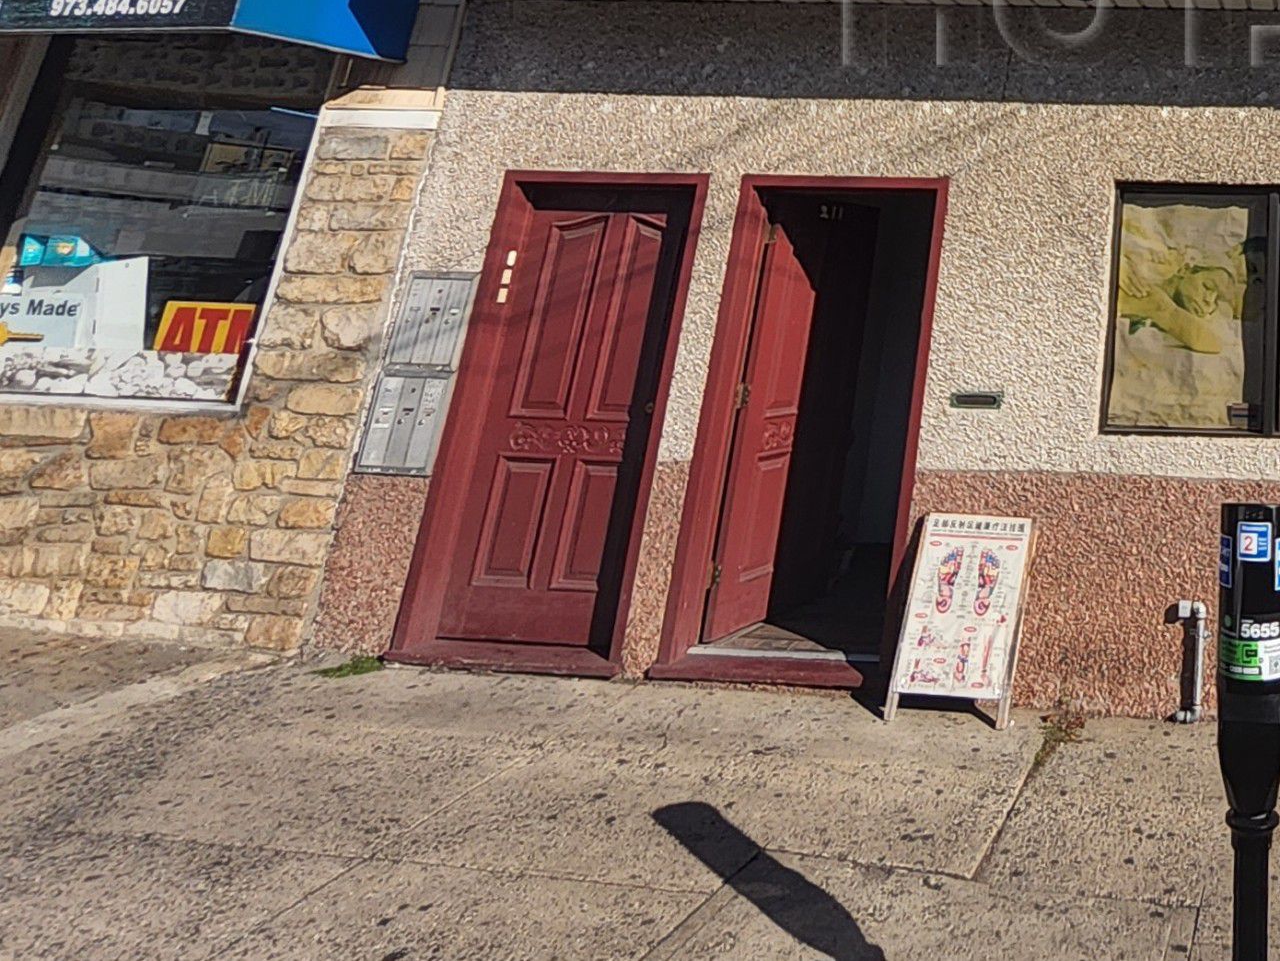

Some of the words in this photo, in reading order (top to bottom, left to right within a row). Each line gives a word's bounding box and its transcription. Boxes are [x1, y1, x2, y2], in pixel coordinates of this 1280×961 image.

[26, 299, 79, 316] Made
[1244, 535, 1254, 551] 2
[1241, 622, 1280, 638] 5655
